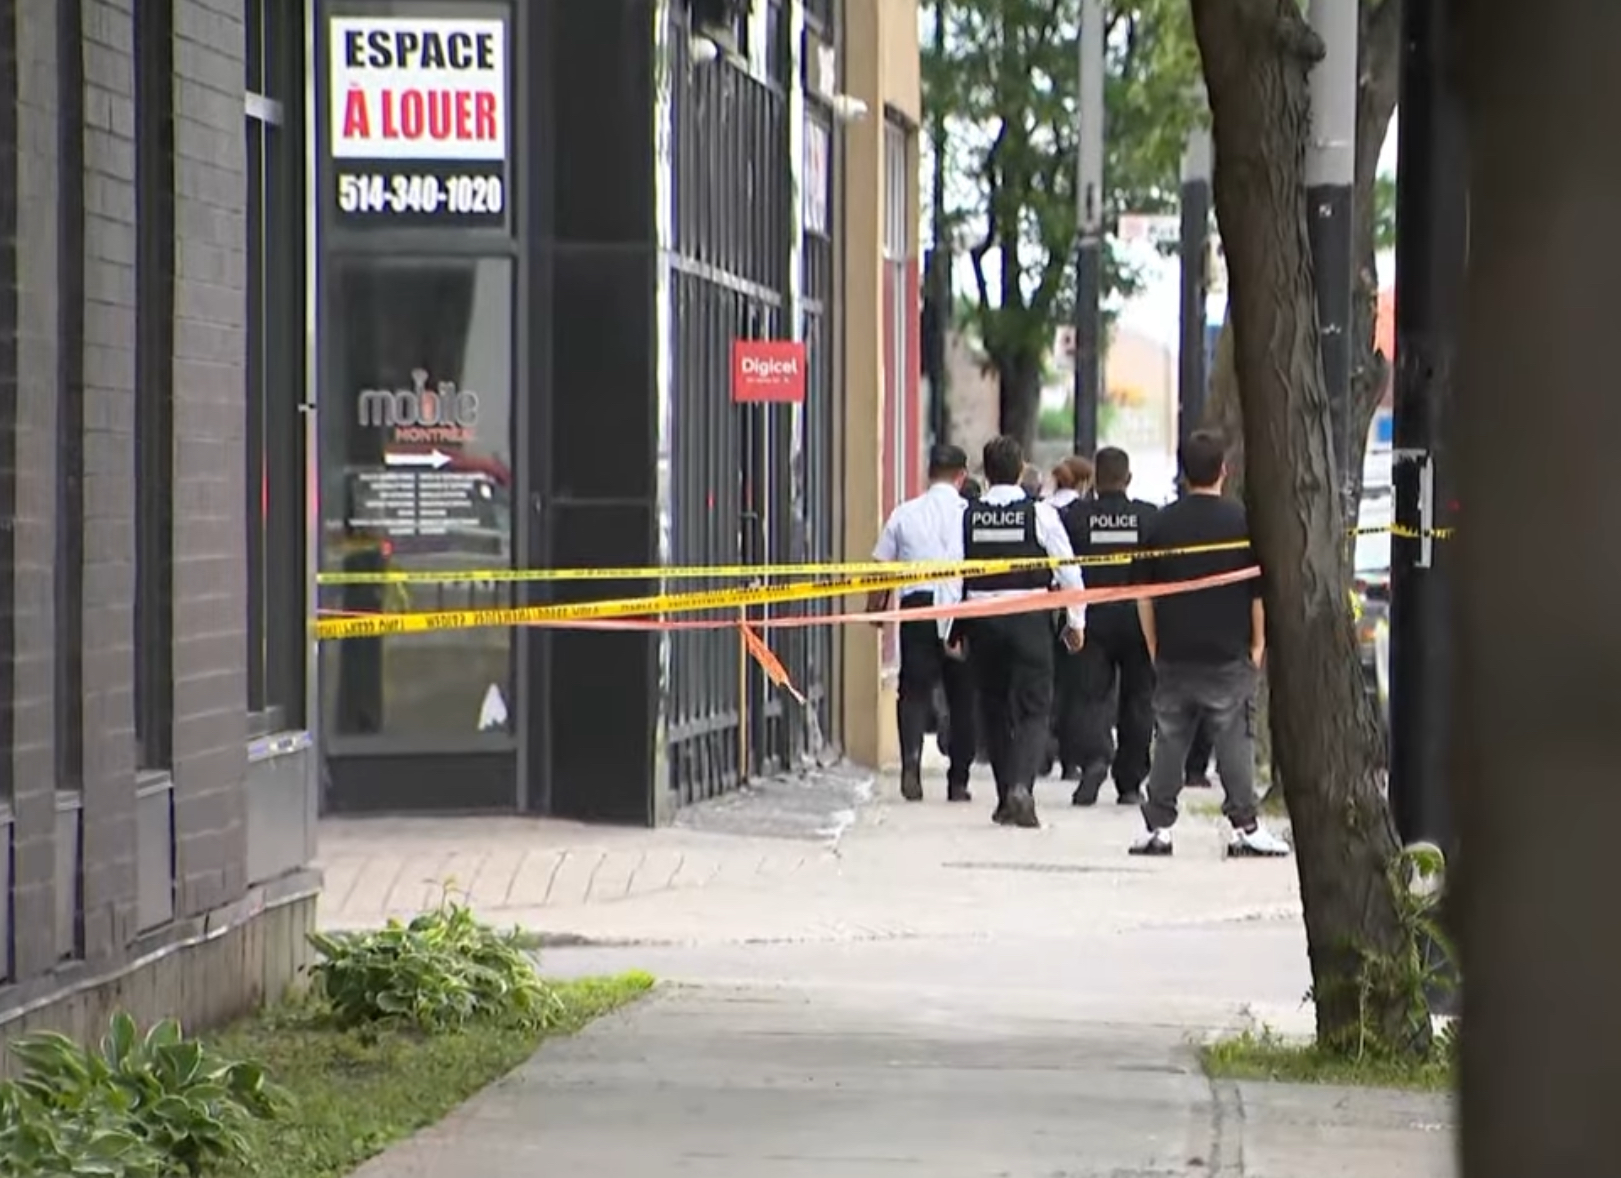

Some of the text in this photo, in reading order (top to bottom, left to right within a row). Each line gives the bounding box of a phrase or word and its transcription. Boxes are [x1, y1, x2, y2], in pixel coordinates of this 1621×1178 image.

[345, 30, 494, 69] ESPACE
[343, 82, 497, 140] À LOUER
[339, 174, 502, 213] 514-340-1020
[742, 357, 797, 377] Digicel
[972, 511, 1025, 526] POLICE
[1090, 515, 1138, 528] POLICE
